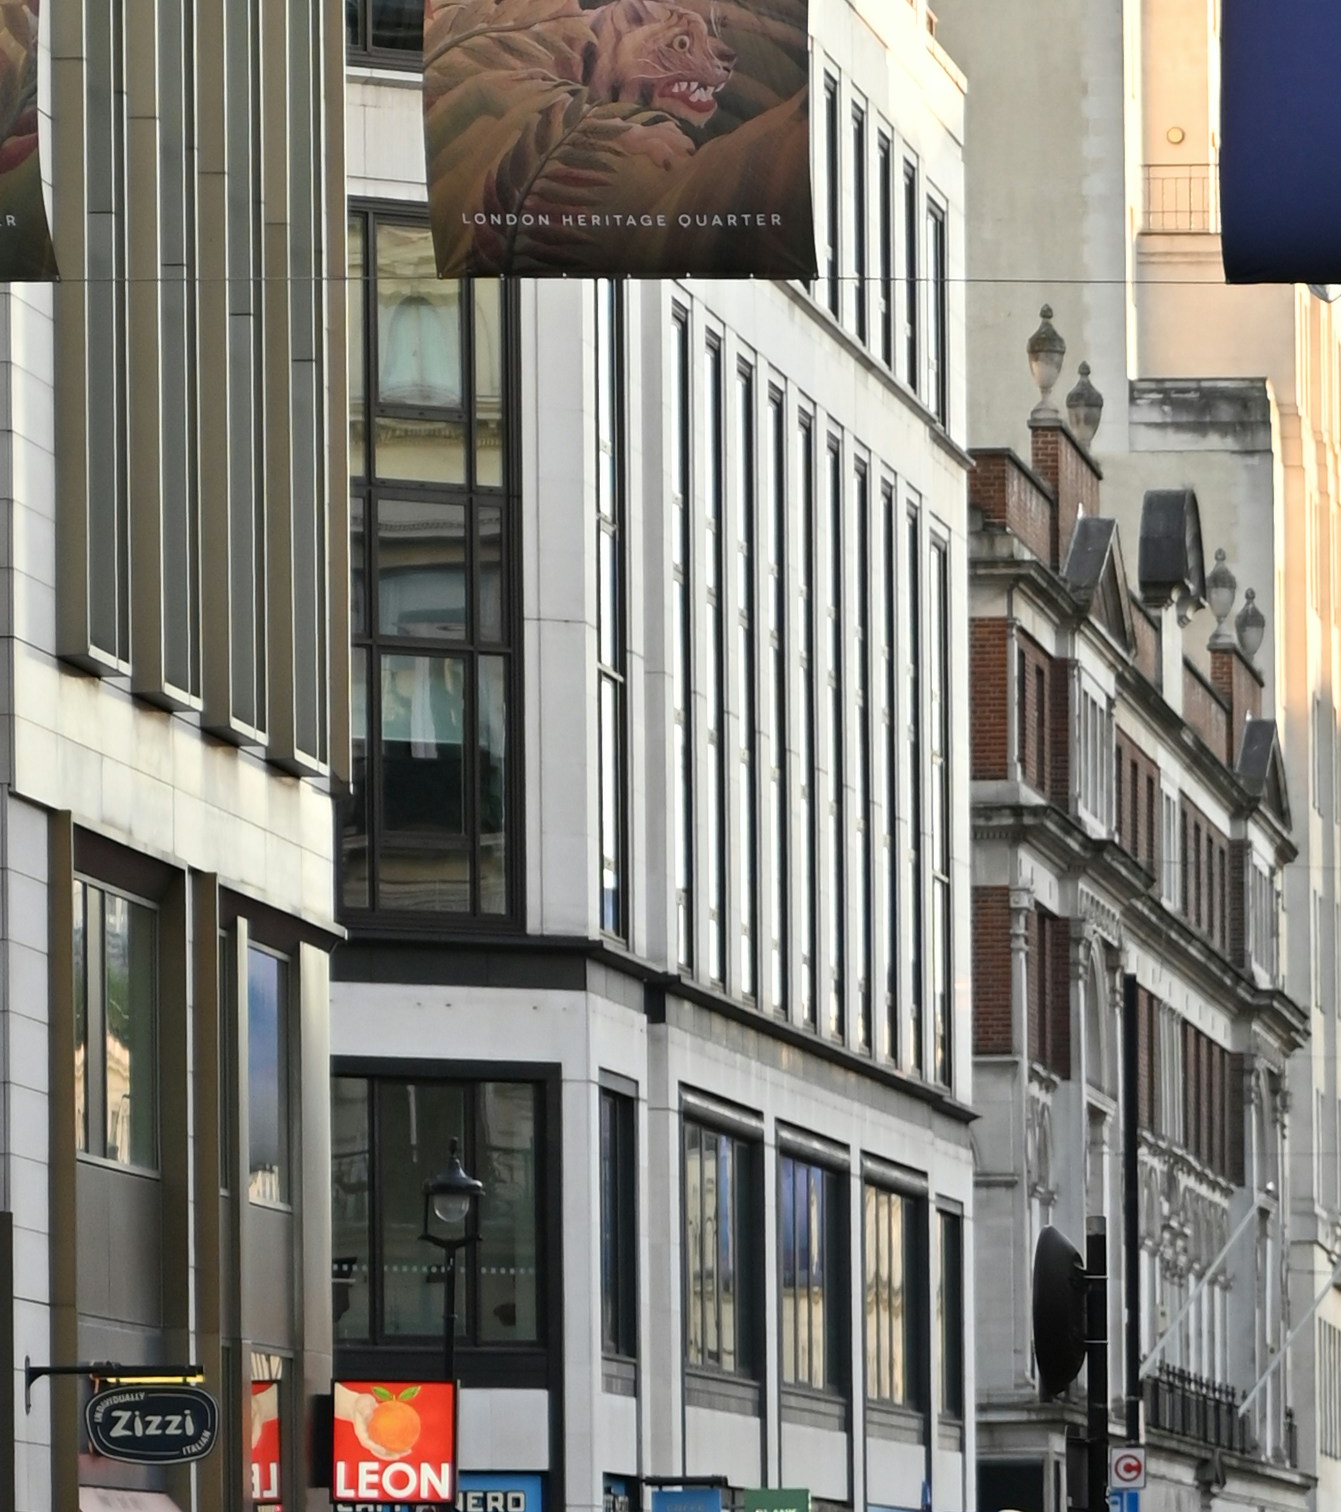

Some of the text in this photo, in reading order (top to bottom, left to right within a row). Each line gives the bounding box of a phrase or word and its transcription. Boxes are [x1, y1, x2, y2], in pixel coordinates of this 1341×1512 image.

[462, 212, 783, 229] LONDON HERITAGE QUARTER
[94, 1392, 146, 1423] INDIVIDUALLY
[109, 1409, 195, 1437] Zizzi
[182, 1429, 211, 1455] ITALIAN
[336, 1461, 450, 1500] LEON
